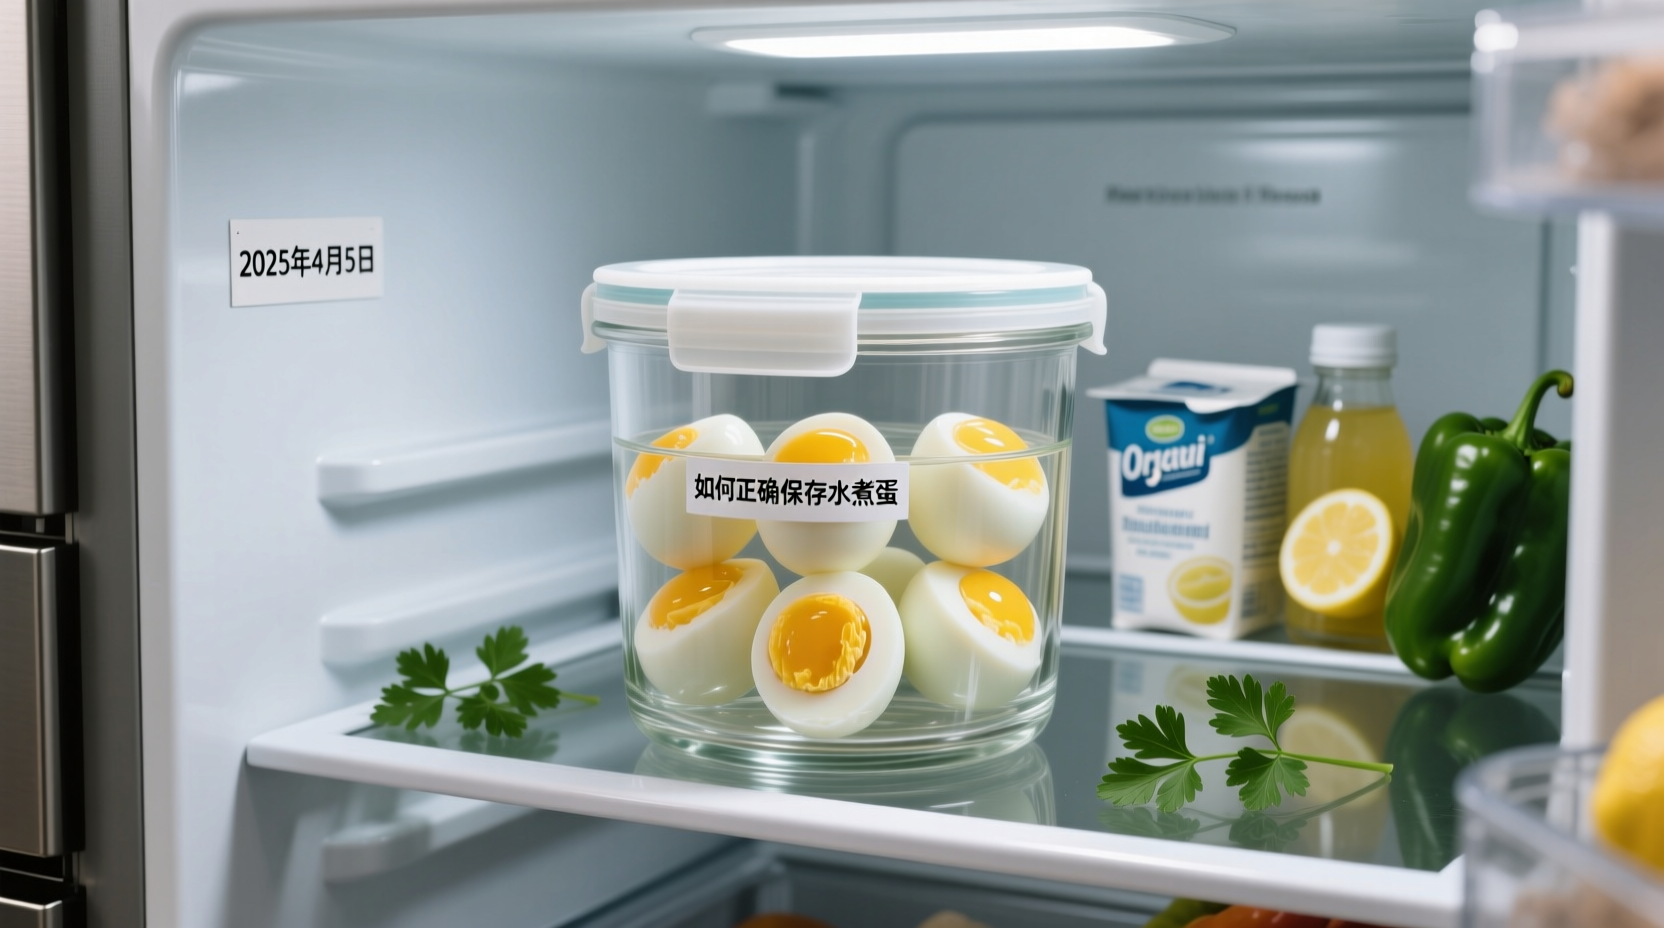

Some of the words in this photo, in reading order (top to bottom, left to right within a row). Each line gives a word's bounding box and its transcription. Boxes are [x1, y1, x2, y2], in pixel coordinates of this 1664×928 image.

[239, 245, 373, 278] 2025年4月5日
[694, 473, 898, 507] 如何正确保存水煮蛋
